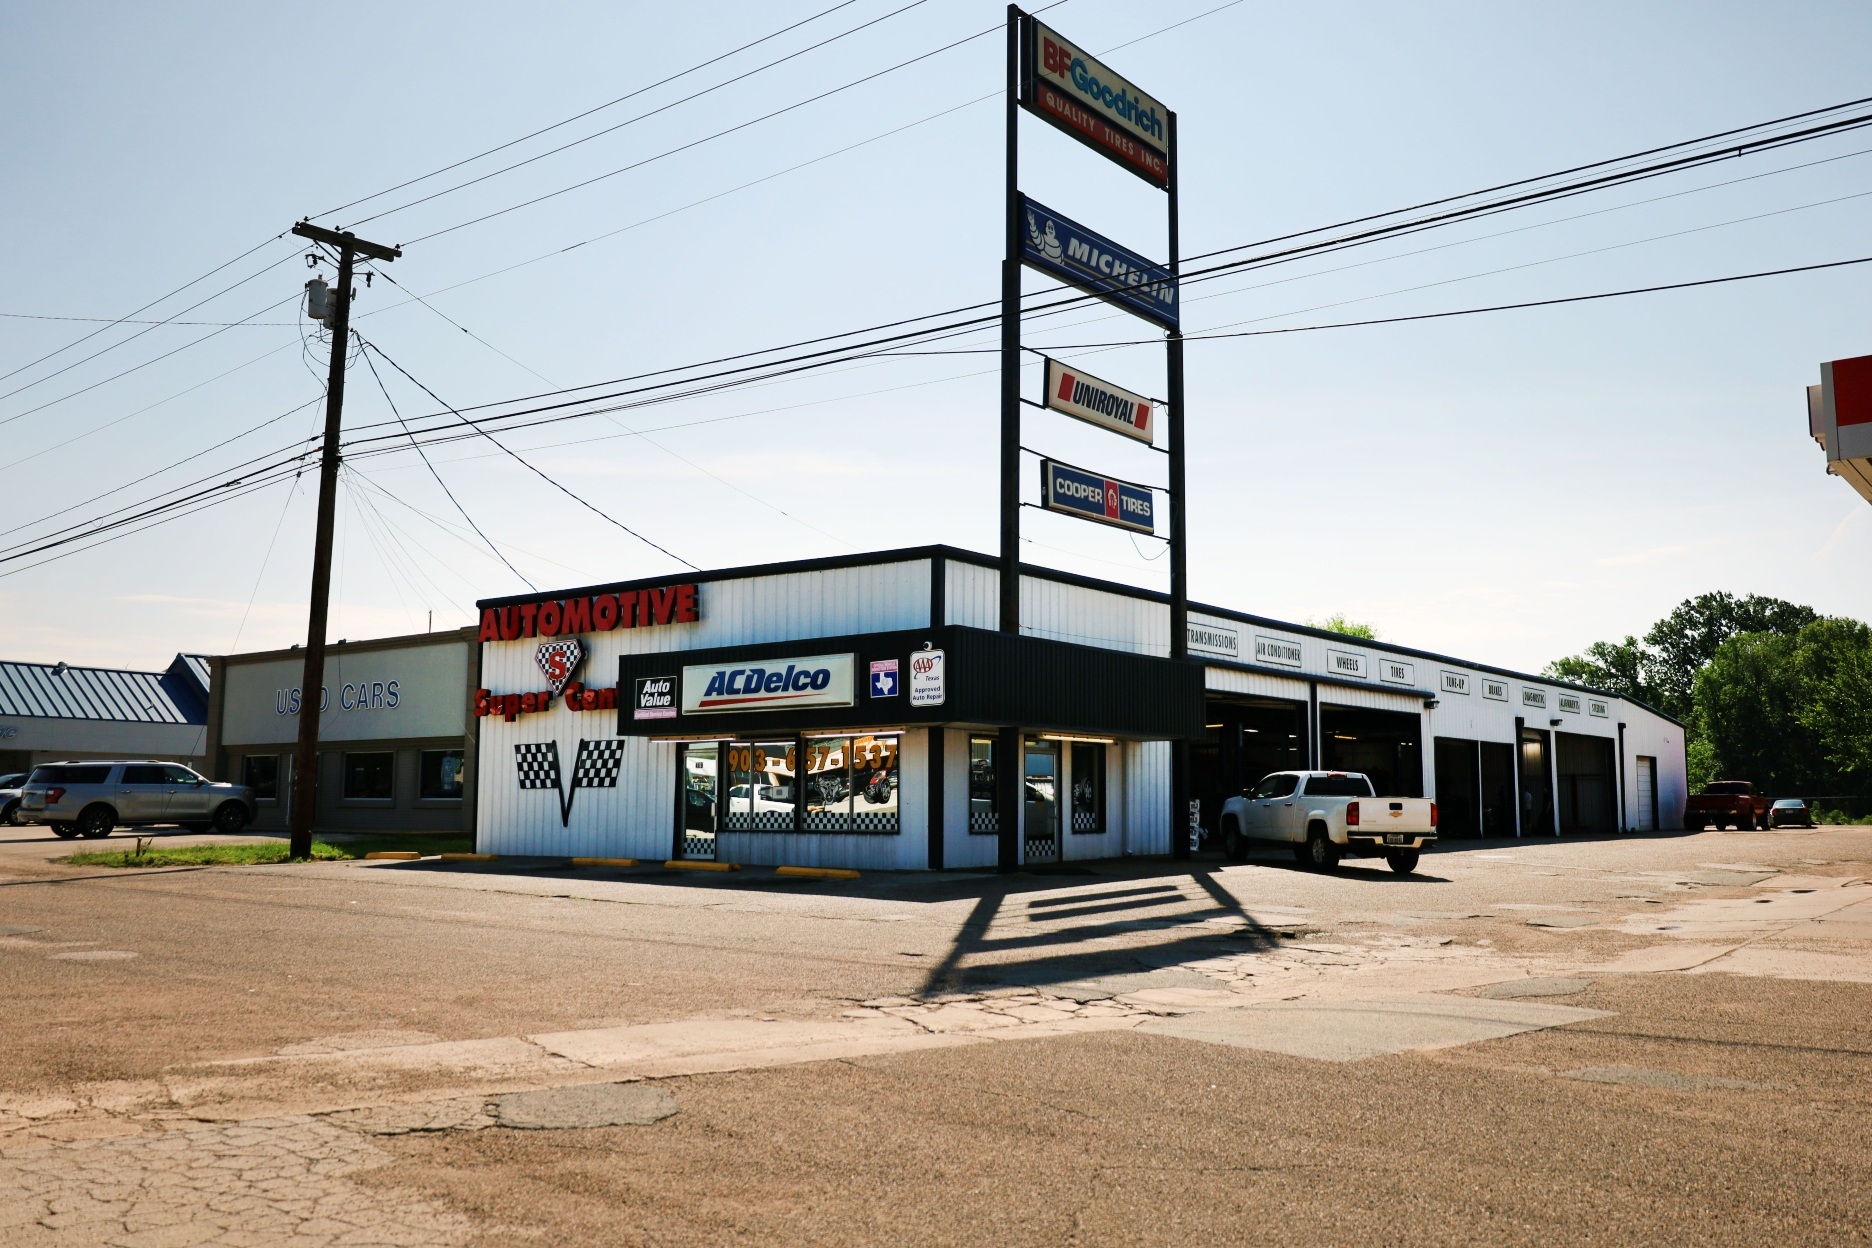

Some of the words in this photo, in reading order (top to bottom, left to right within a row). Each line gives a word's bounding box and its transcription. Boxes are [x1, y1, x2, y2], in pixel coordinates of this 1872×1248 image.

[1043, 36, 1163, 142] BFGoodrich
[1045, 91, 1096, 132] QUALITY
[1104, 127, 1134, 156] TIRES
[1141, 152, 1163, 174] INC.
[1067, 237, 1175, 305] MICHELIN
[1073, 380, 1135, 425] UNIROYAL
[1056, 478, 1103, 504] COOPER
[1121, 495, 1151, 517] TIRES
[478, 584, 699, 642] AUTOMOTIVE
[1187, 629, 1237, 651] TRANSMISSIONS
[1257, 642, 1266, 656] AIR
[1267, 643, 1301, 662] CONDITIONER
[913, 658, 933, 673] AAA
[1336, 656, 1359, 672] WHEELS
[1390, 665, 1405, 679] TIRES
[642, 679, 671, 693] Auto
[703, 664, 831, 697] ACDelco
[914, 685, 941, 694] Approved
[276, 686, 329, 715] USD
[340, 680, 401, 711] CARS
[474, 688, 553, 722] Super
[565, 681, 618, 712] Cen
[640, 692, 671, 707] Value
[926, 692, 943, 701] Repair
